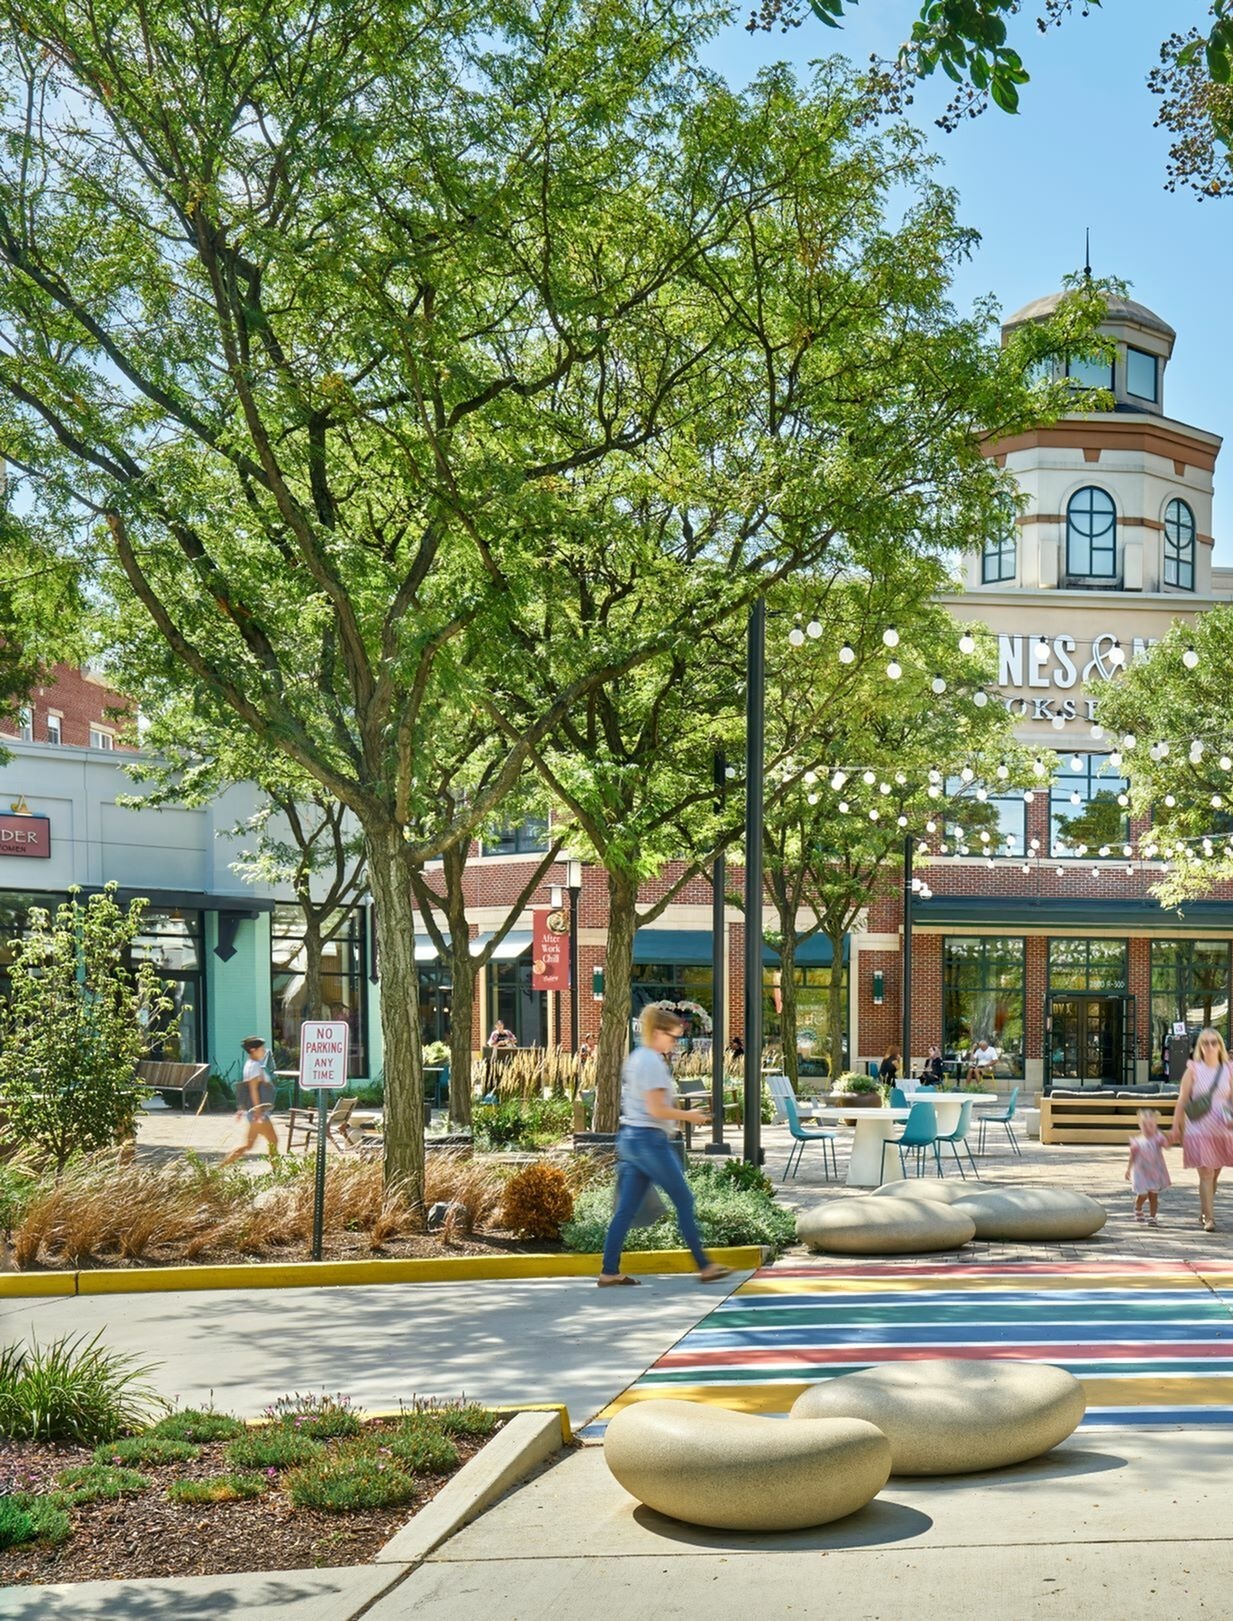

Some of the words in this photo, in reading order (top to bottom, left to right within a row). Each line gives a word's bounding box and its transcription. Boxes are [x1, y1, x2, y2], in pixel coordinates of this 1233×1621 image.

[998, 633, 1077, 689] NES
[0, 843, 27, 854] OMEN
[541, 934, 561, 943] After
[541, 943, 561, 953] Work
[542, 953, 560, 963] Chill
[316, 1027, 333, 1040] NO
[305, 1041, 343, 1054] PARKING
[314, 1058, 334, 1068] ANY
[312, 1070, 334, 1080] TIME
